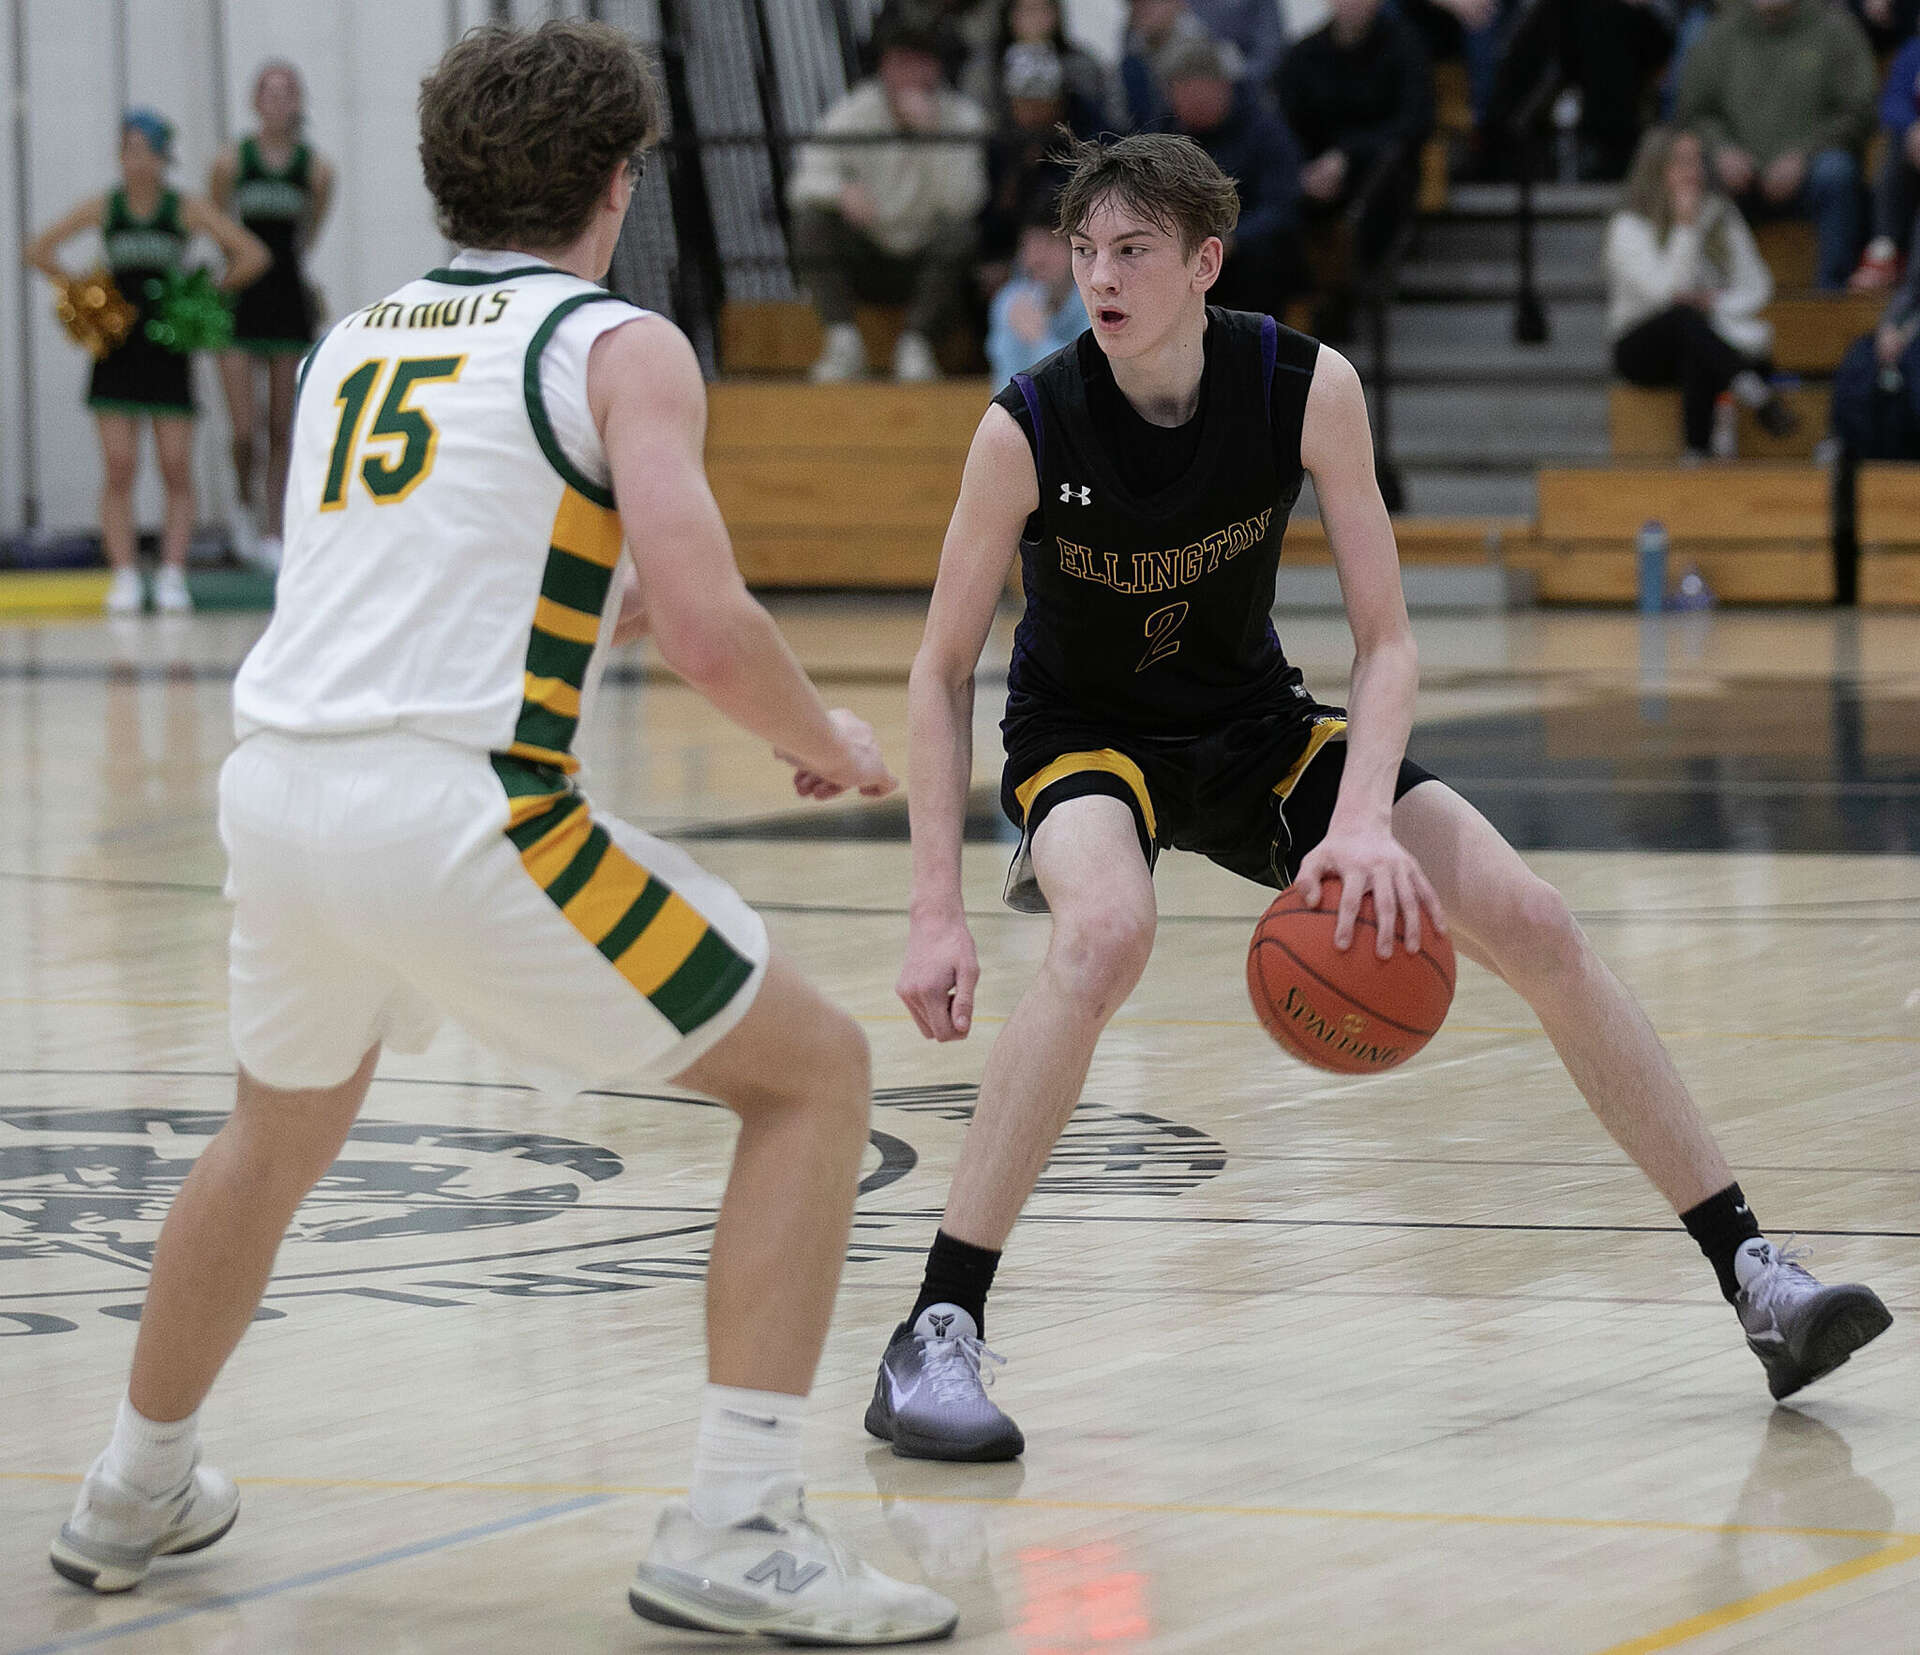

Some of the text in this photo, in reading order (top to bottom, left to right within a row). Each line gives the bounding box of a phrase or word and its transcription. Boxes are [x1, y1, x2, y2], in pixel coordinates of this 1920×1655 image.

[320, 354, 469, 513] 15
[1056, 507, 1272, 594] ELLINGTON
[1135, 601, 1189, 673] 2
[1278, 985, 1404, 1065] SPALDING
